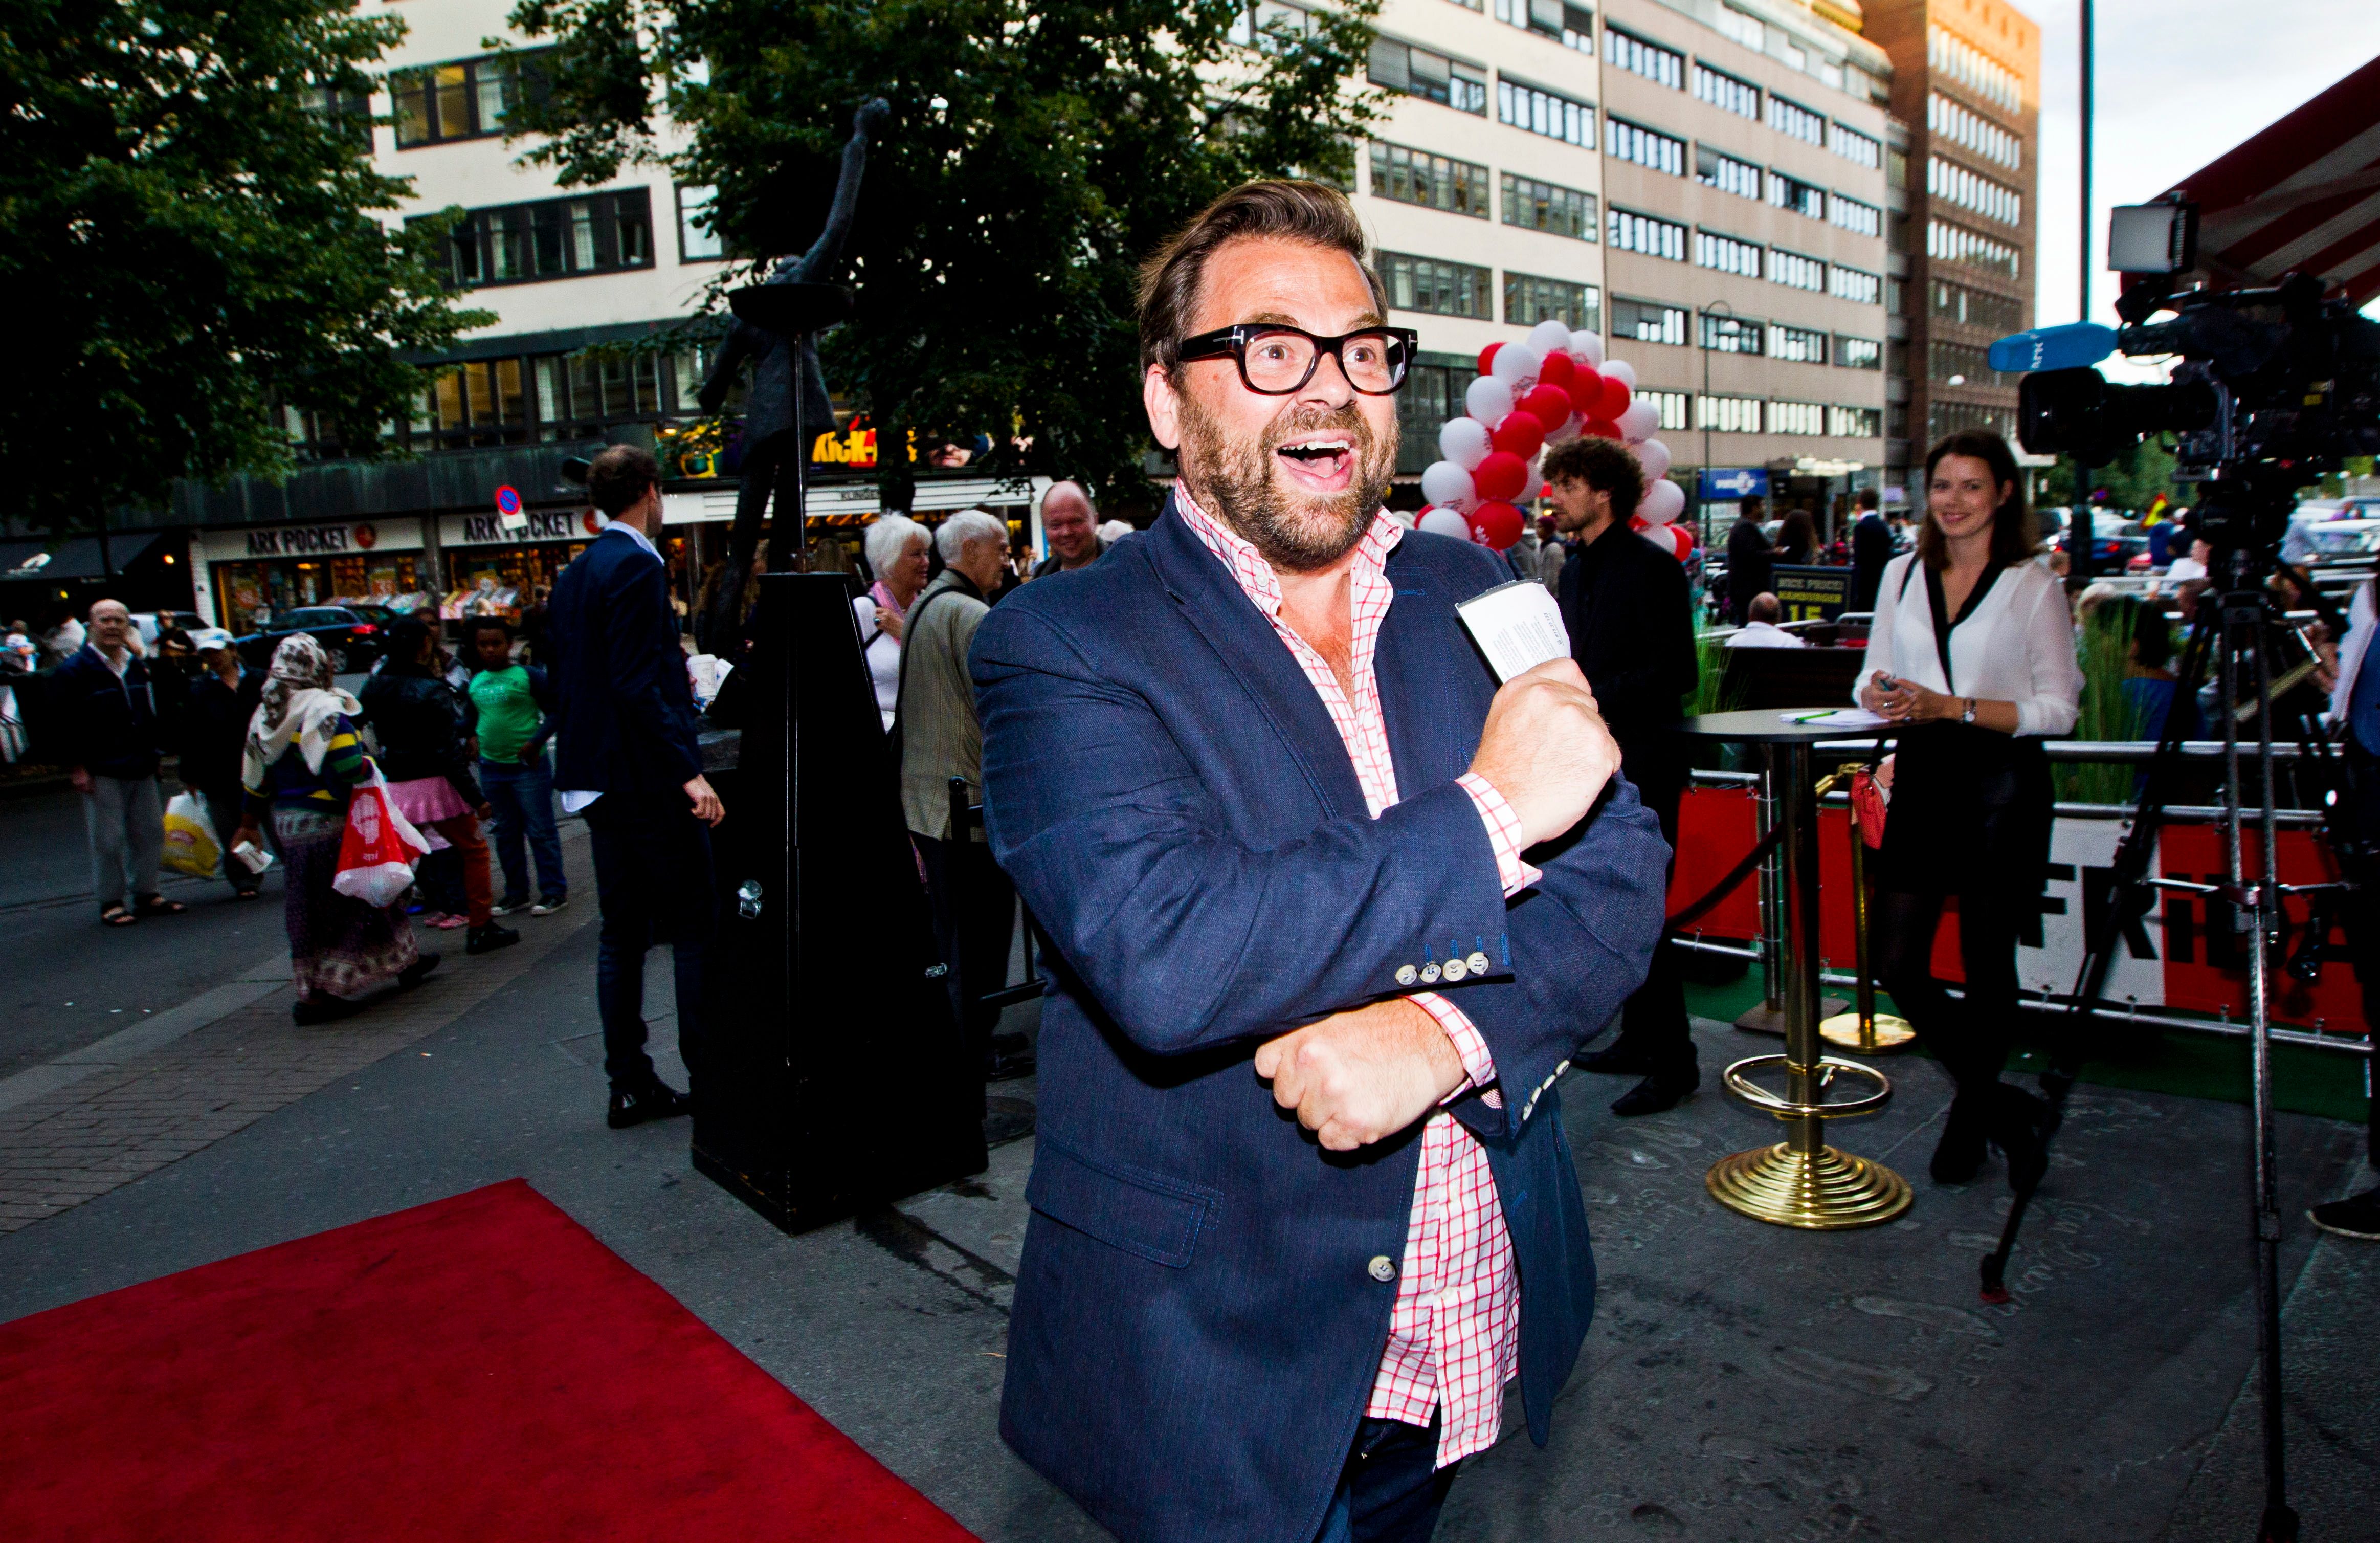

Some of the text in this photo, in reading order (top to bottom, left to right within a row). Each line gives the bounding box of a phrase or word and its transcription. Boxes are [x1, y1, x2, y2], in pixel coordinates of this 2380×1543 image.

[247, 526, 348, 554] ARK POCKET
[464, 512, 574, 541] ARK OCKET
